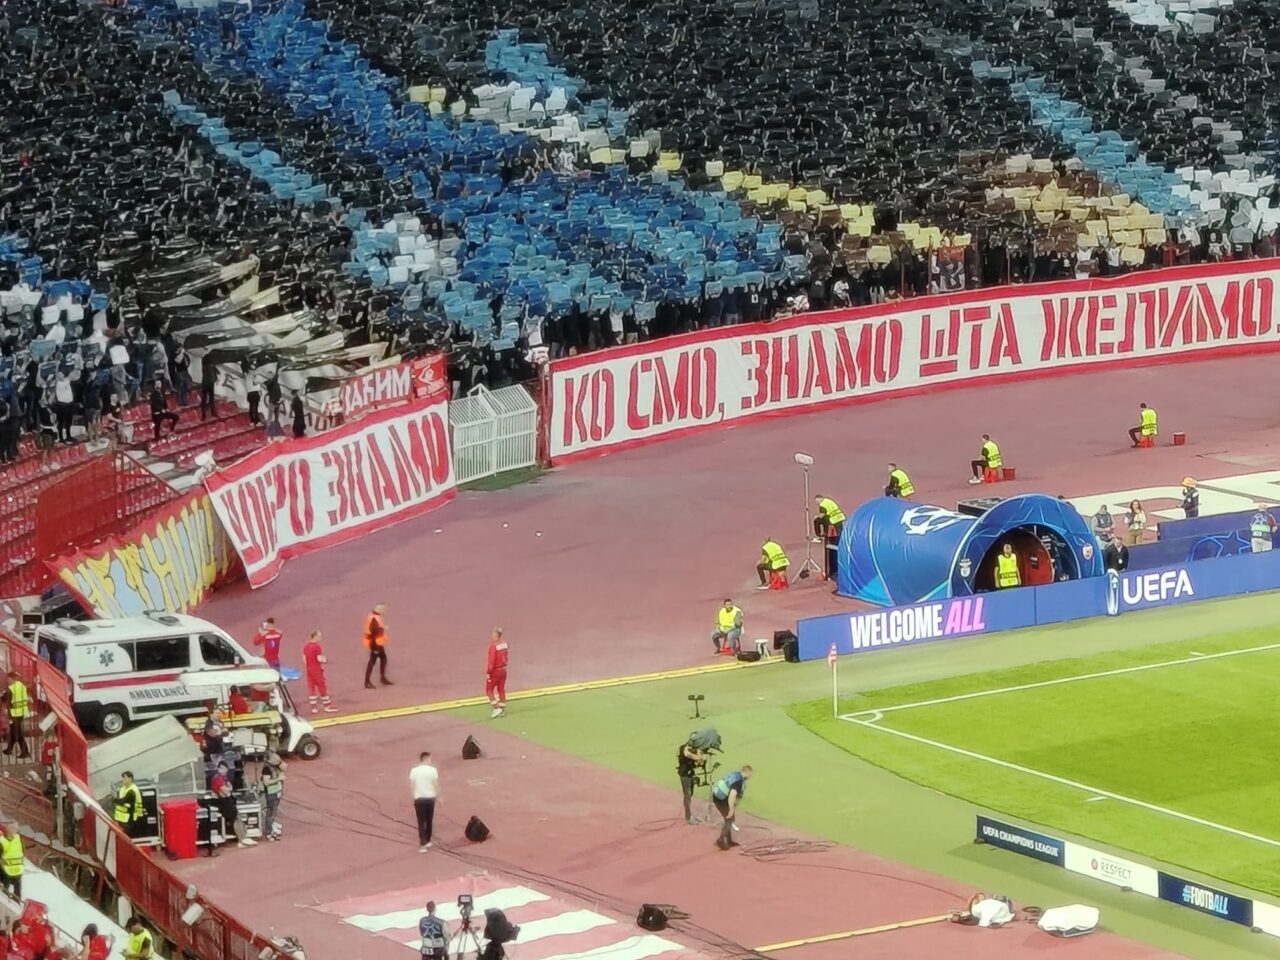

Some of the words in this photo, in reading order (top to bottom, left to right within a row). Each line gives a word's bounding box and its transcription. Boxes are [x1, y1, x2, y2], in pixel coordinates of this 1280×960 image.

[563, 372, 615, 446] КО
[627, 345, 725, 431] СМО,
[740, 318, 903, 409] ЗНАМО
[919, 303, 1022, 378] ШТА
[321, 412, 450, 526] ЗНАМО
[1122, 568, 1194, 605] UEFA
[850, 604, 943, 649] WELCOME
[944, 597, 985, 635] ALL
[86, 646, 97, 656] 27
[129, 685, 191, 701] AMBULANCE
[982, 825, 999, 839] UEFA
[1000, 830, 1034, 850] CHAMPIONS
[1035, 841, 1059, 857] LEAGUE
[1101, 861, 1133, 880] RESPECT
[1181, 884, 1229, 915] #FOOTBALL
